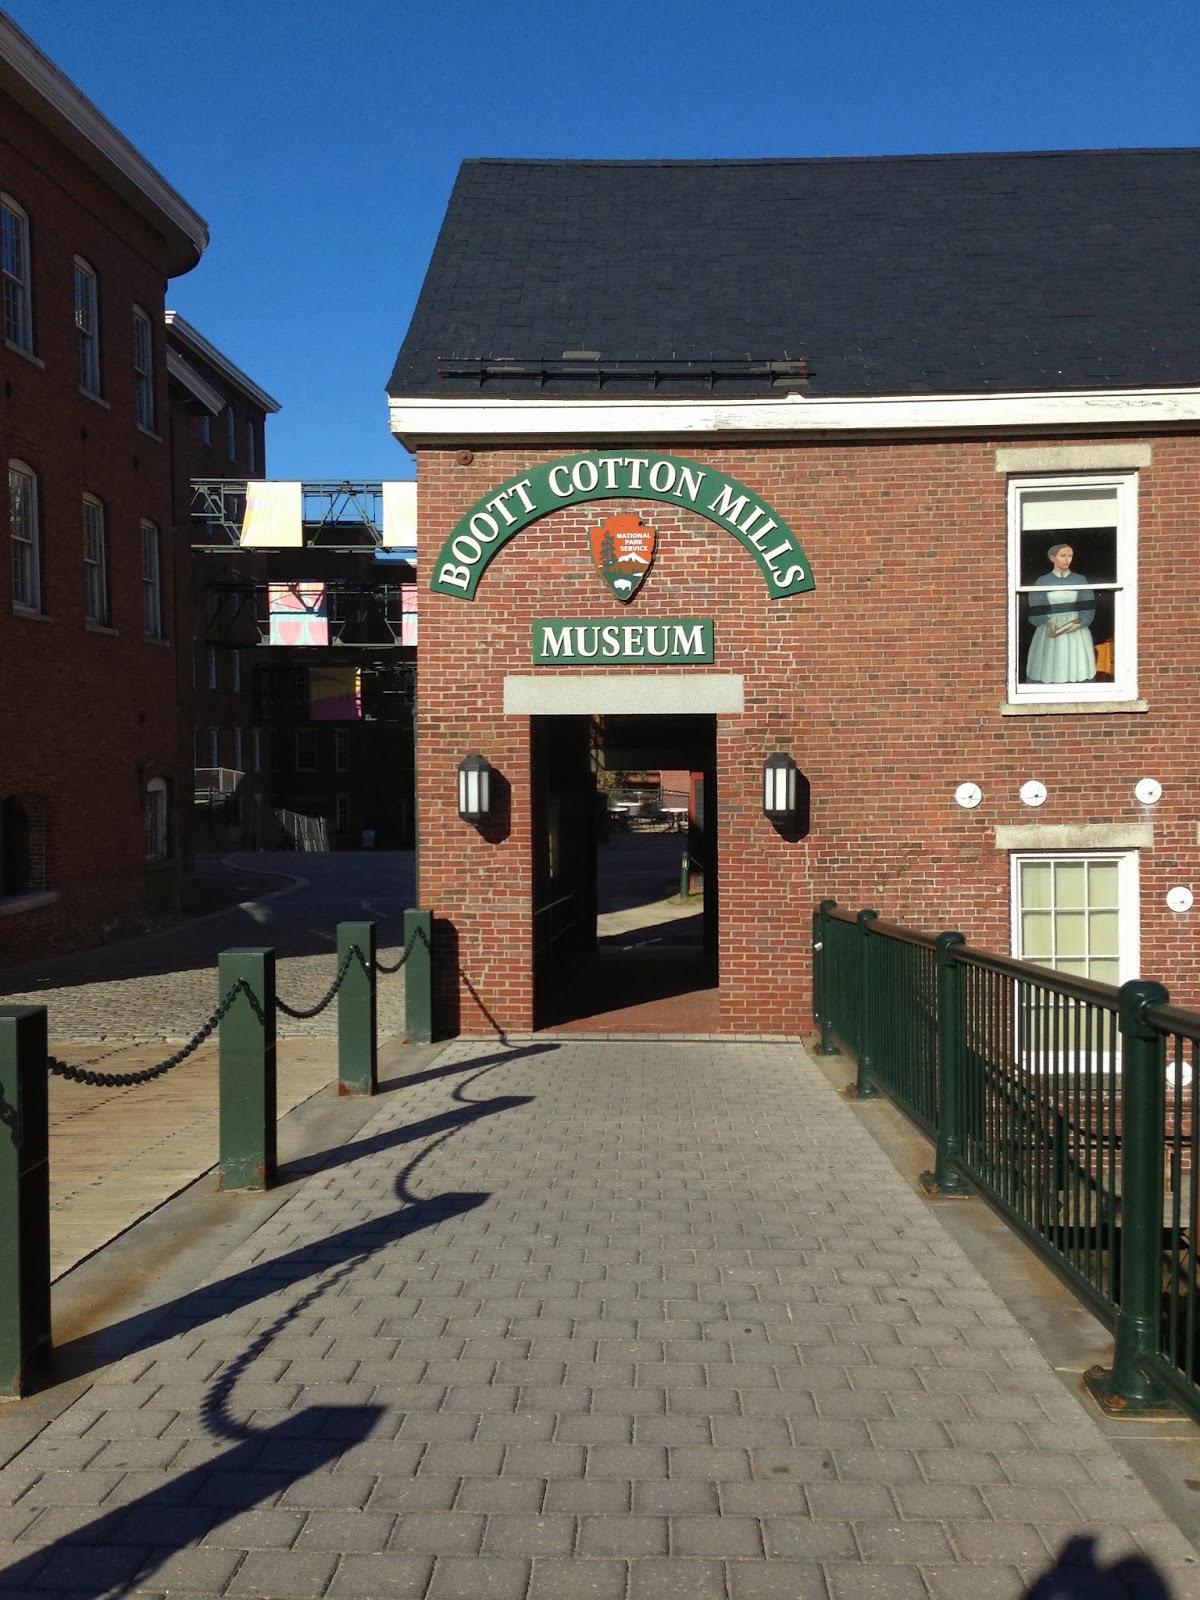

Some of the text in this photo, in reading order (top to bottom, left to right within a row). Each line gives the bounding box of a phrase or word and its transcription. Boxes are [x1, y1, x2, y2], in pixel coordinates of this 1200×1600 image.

[438, 457, 805, 591] BOOTT COTTON MILLS
[540, 625, 706, 657] MUSEUM
